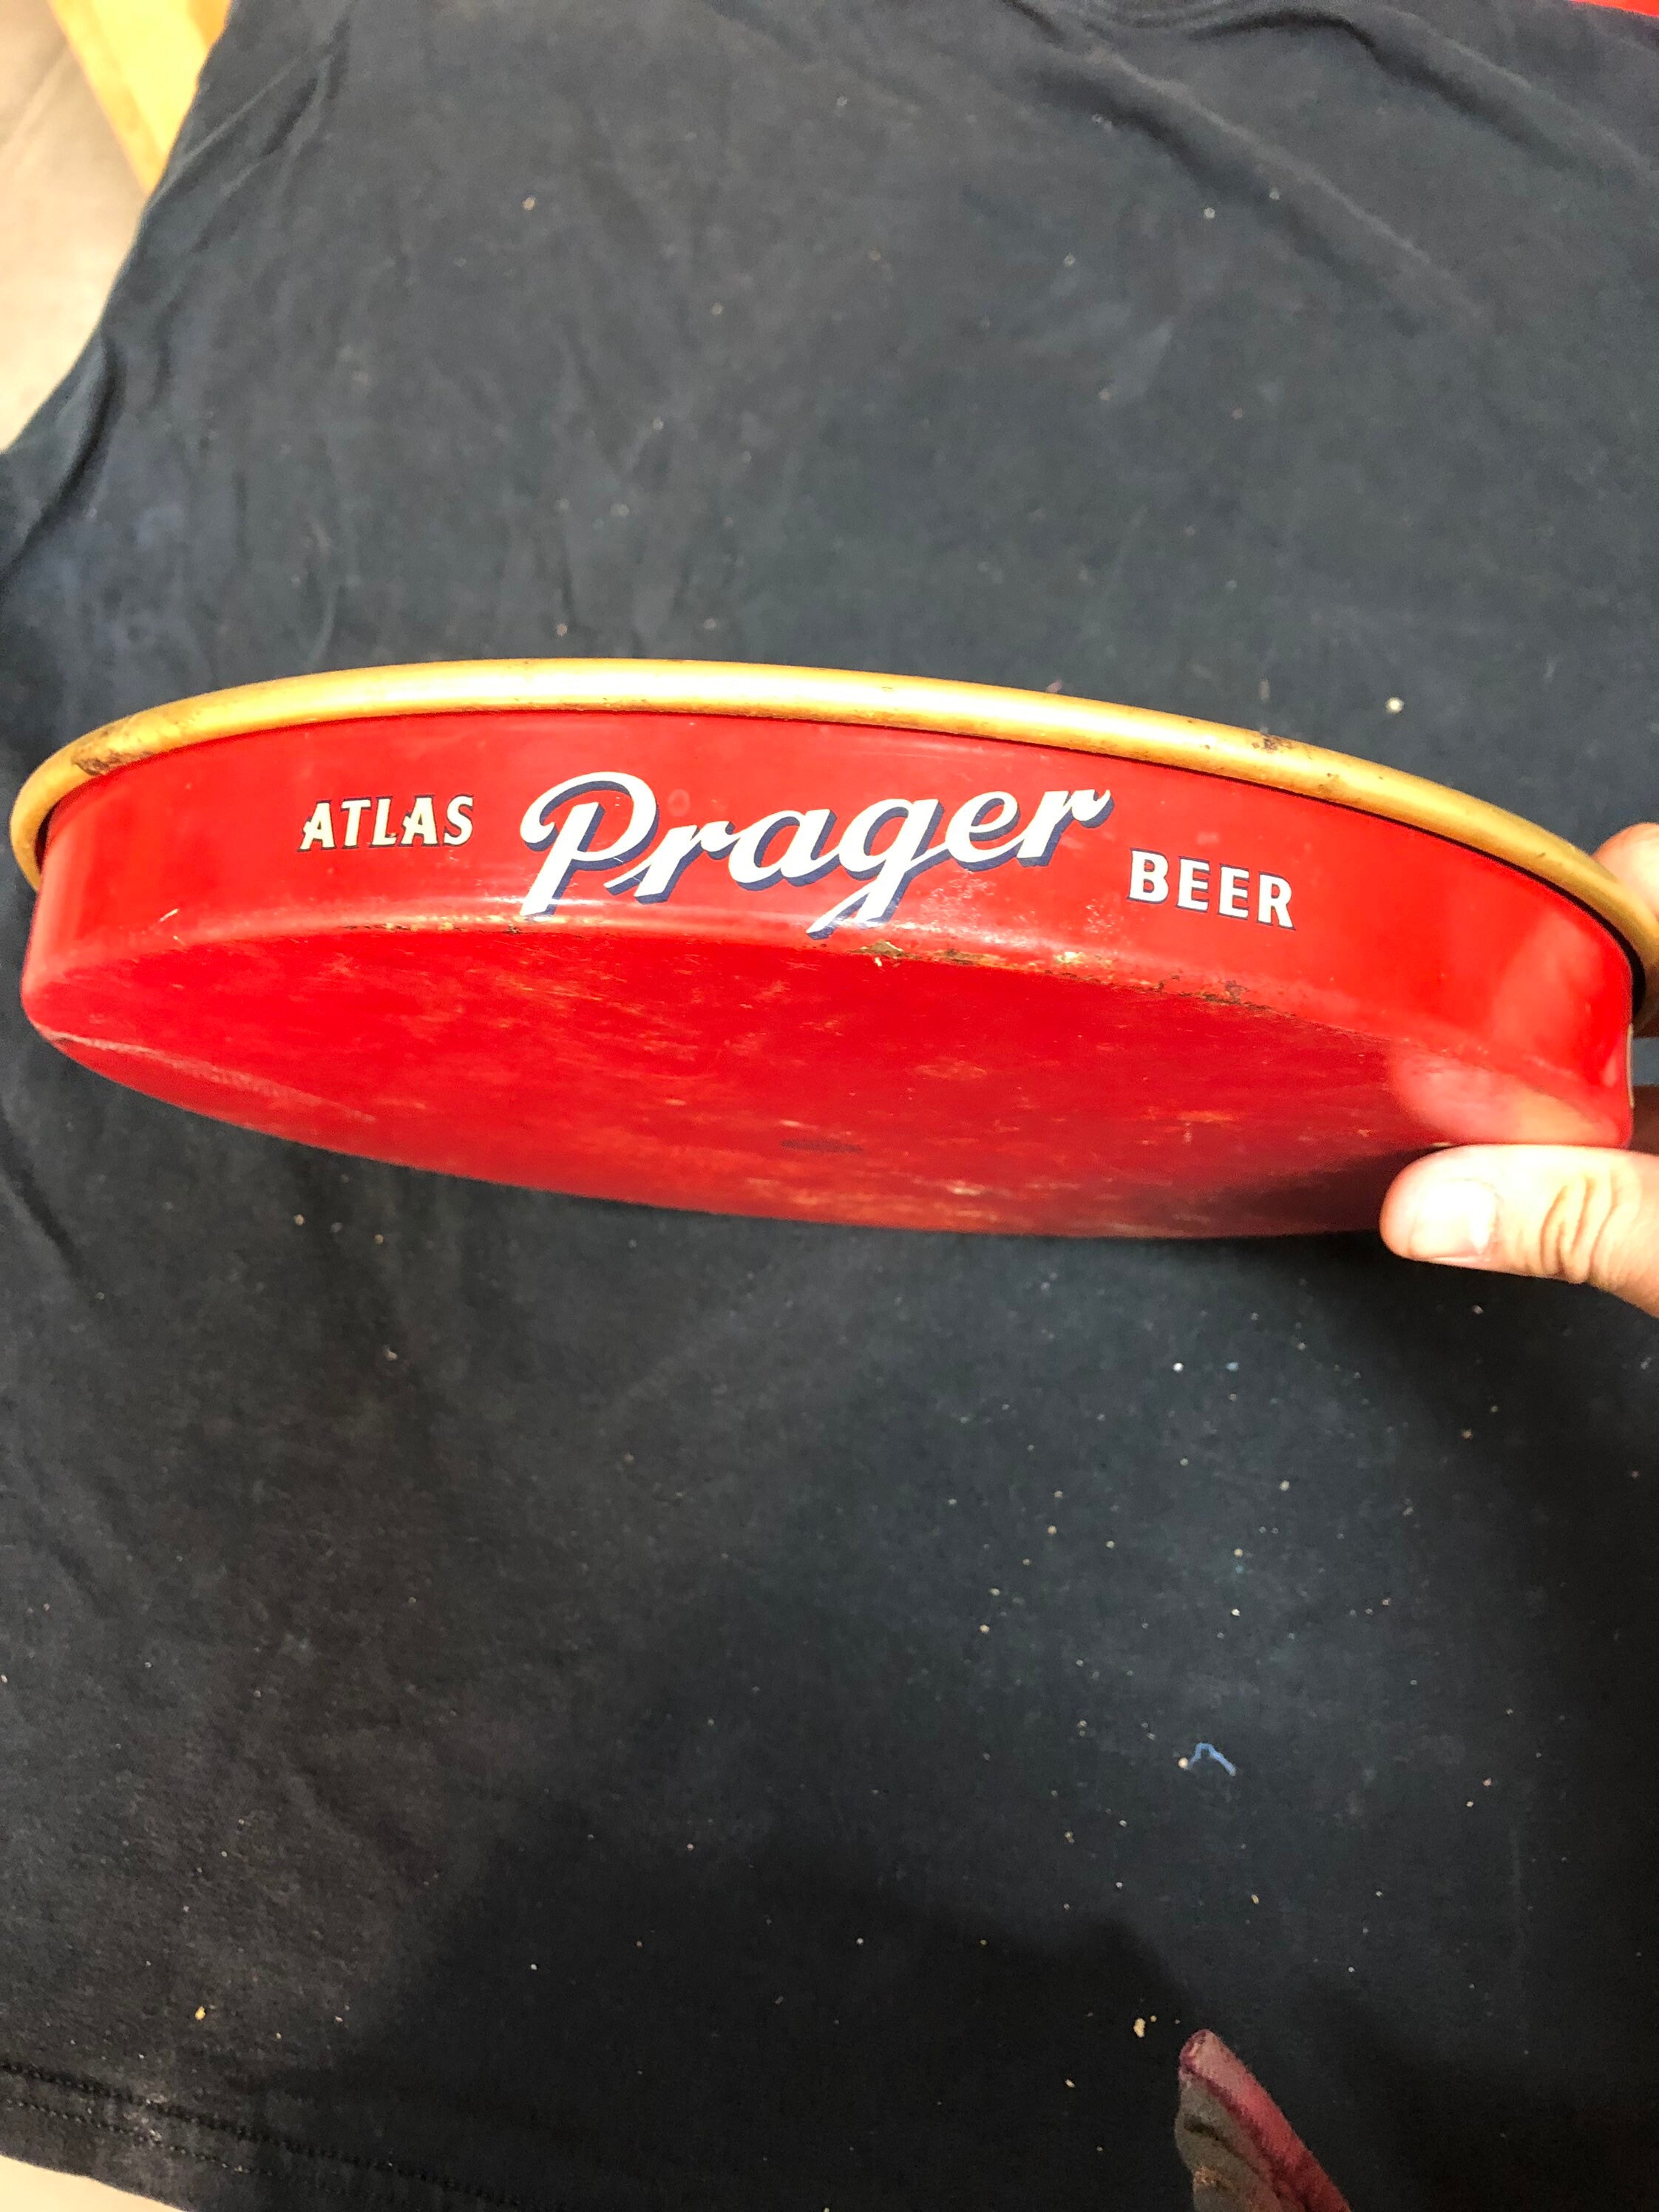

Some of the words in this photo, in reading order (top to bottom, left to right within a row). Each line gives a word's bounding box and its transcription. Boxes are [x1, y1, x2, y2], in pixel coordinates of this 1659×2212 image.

[297, 793, 475, 853] ATLAS
[519, 771, 1115, 940] Prager
[1126, 848, 1296, 931] BEER
